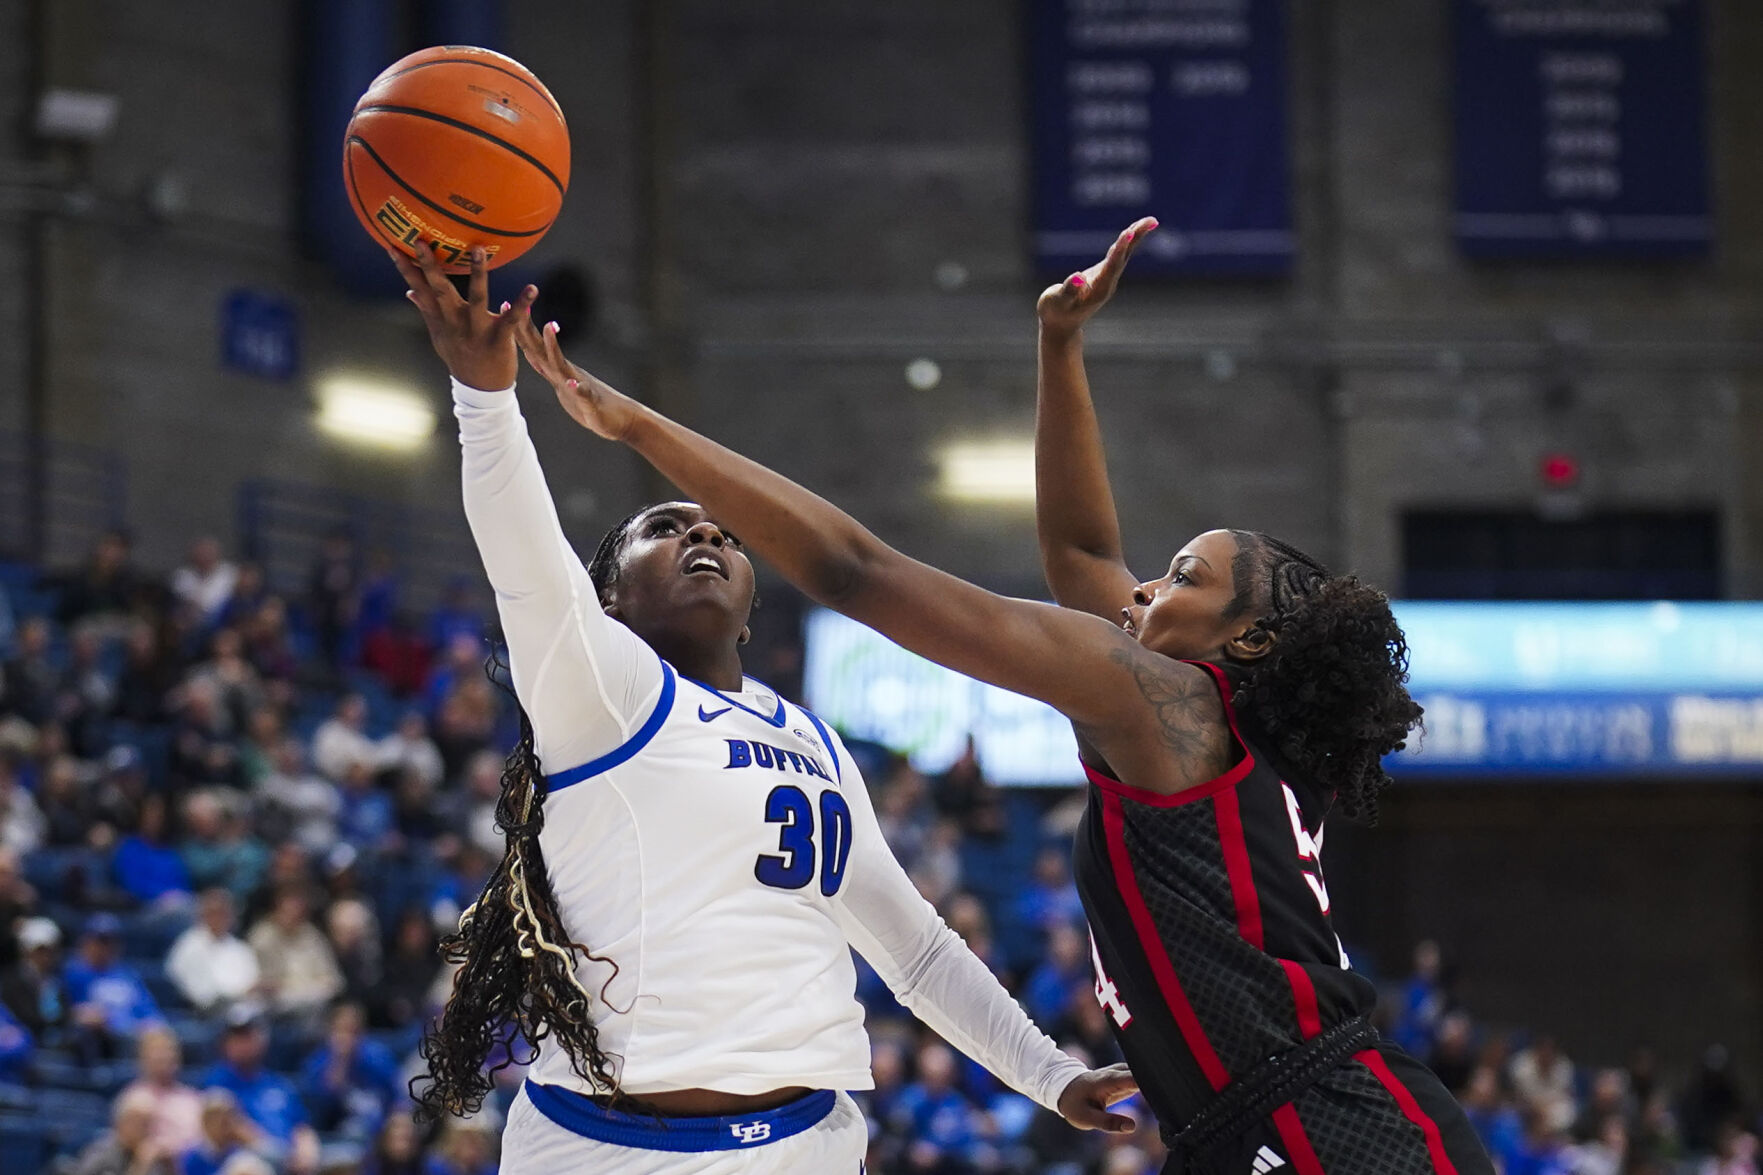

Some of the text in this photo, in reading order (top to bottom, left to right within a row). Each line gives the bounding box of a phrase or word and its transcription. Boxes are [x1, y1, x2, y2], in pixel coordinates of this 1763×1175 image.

[723, 738, 837, 785] BUFFAL
[754, 785, 853, 897] 30
[1087, 920, 1133, 1031] 4
[729, 1120, 771, 1144] UB
